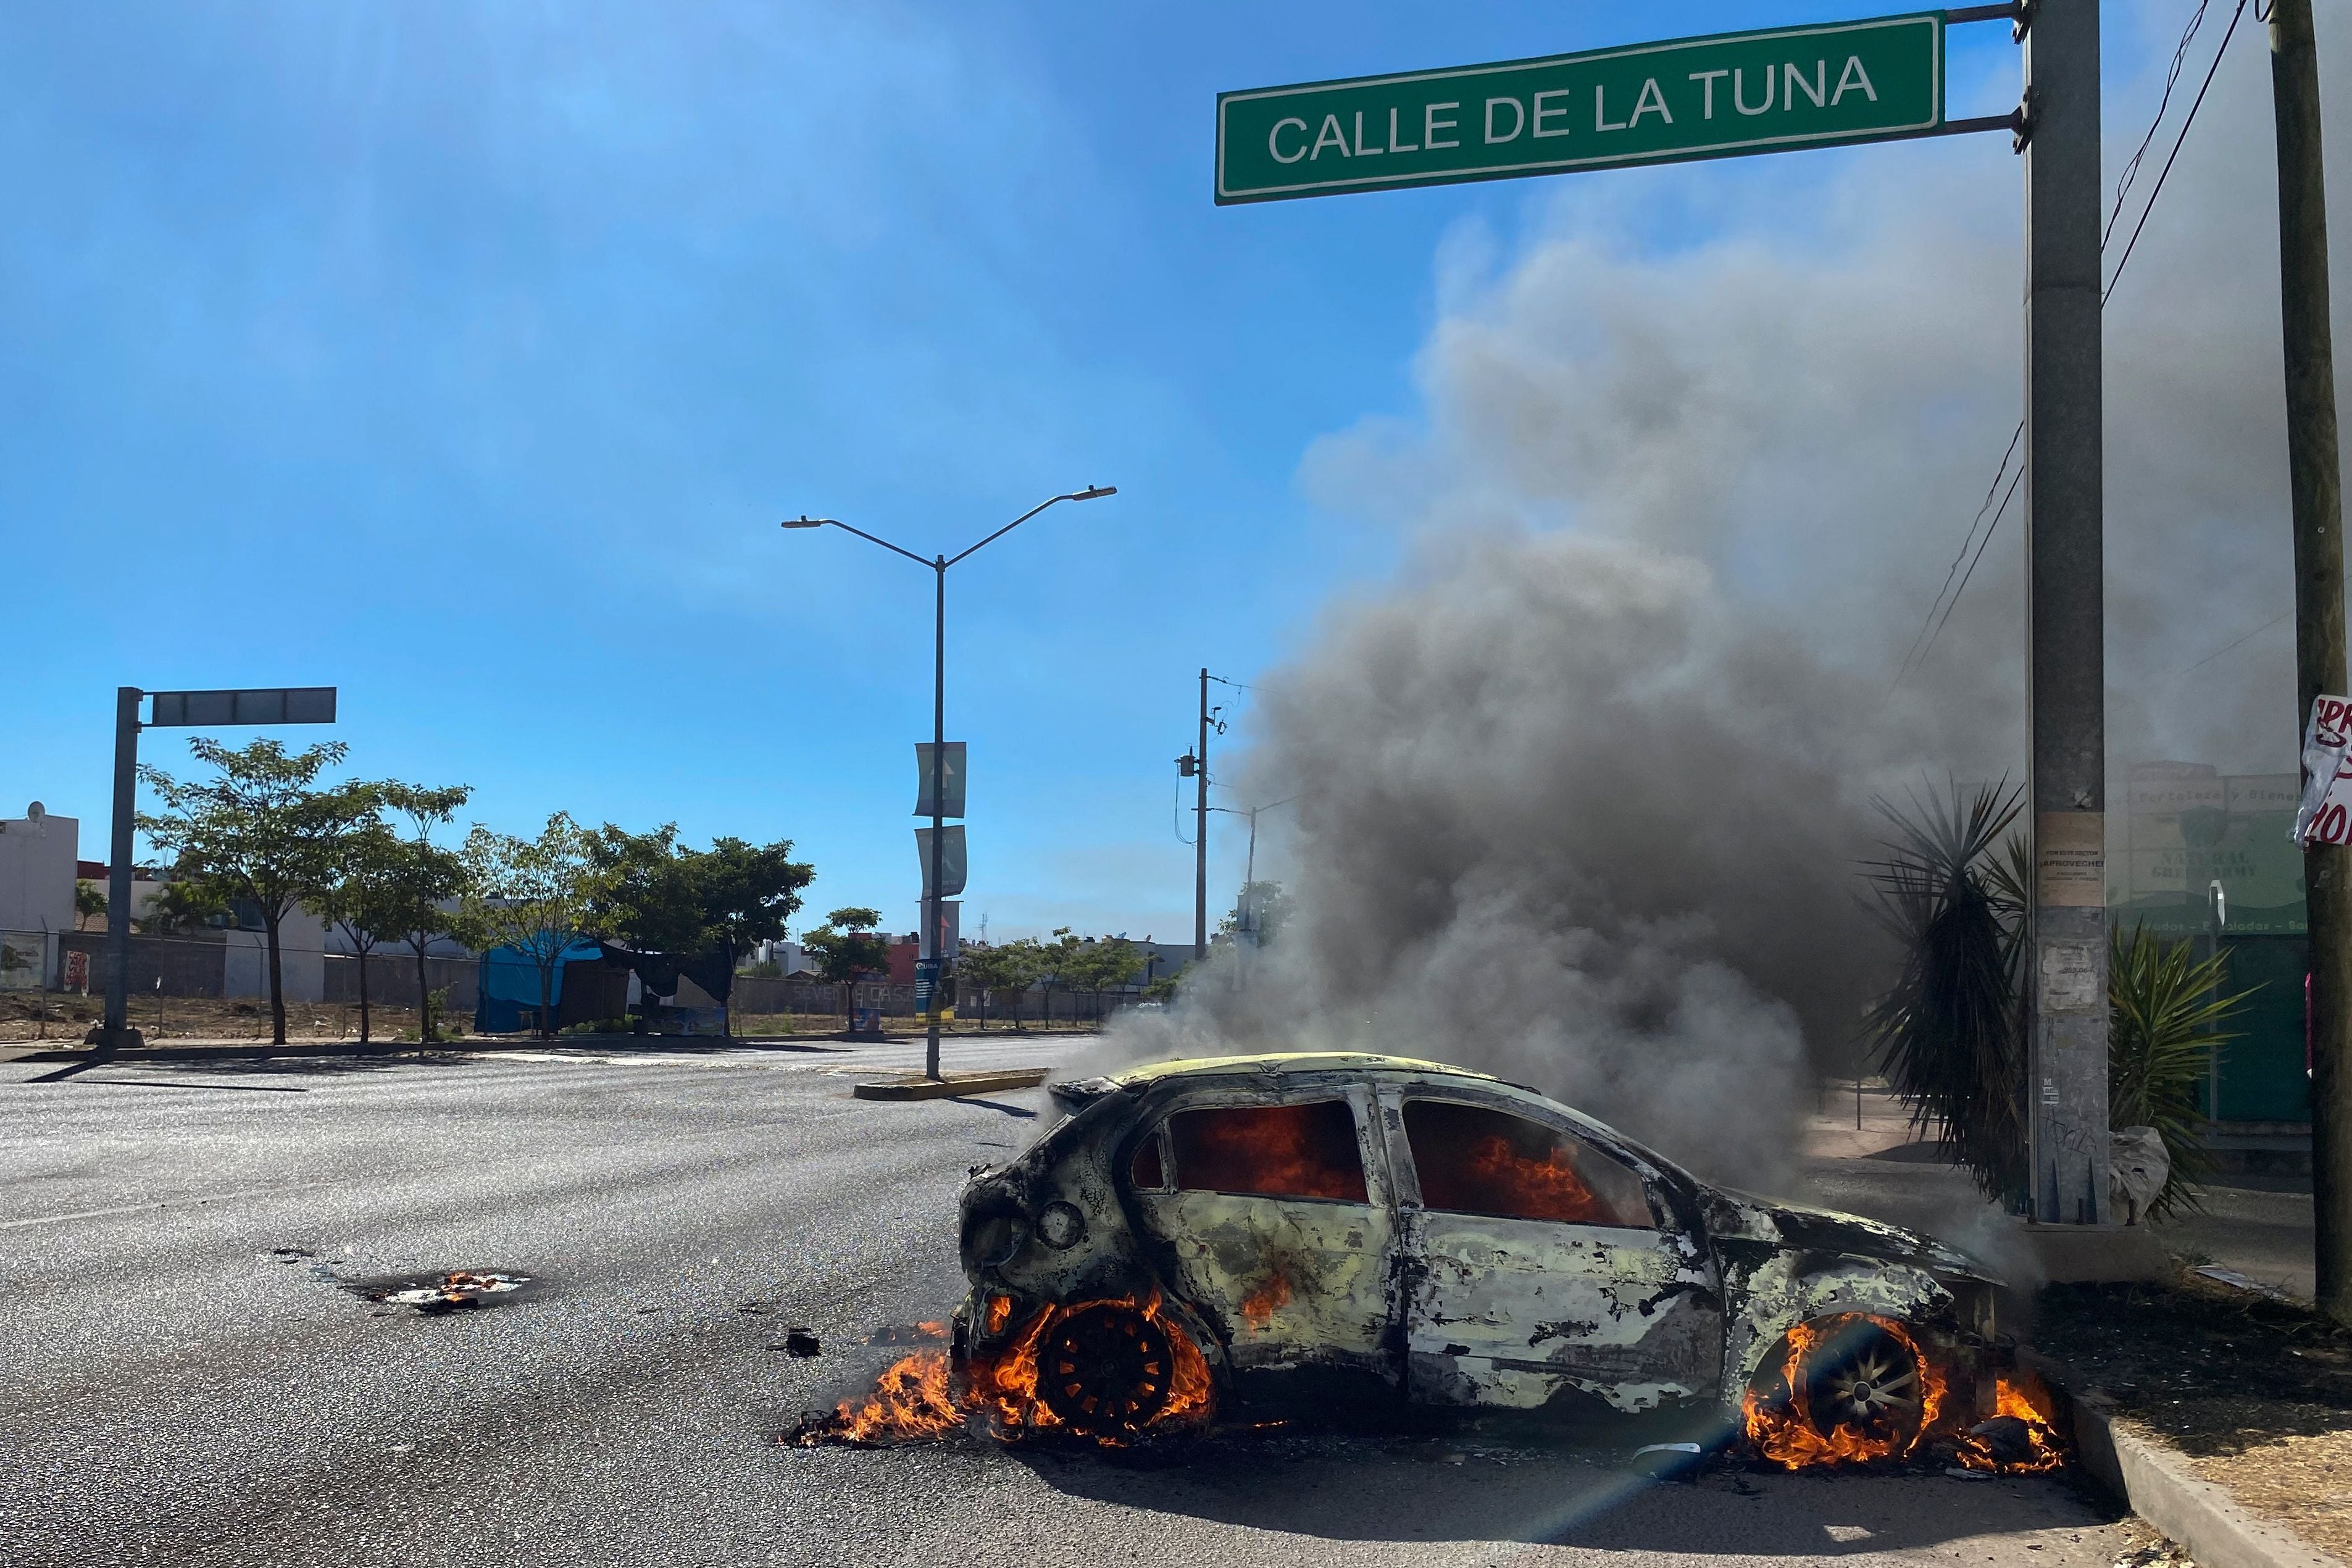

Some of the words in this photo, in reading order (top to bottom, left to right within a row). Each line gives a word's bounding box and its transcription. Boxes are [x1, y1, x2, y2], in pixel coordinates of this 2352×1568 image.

[1269, 102, 1459, 164] CALLE
[1485, 89, 1569, 144] DE
[1596, 78, 1674, 131] LA
[1689, 56, 1877, 120] TUNA
